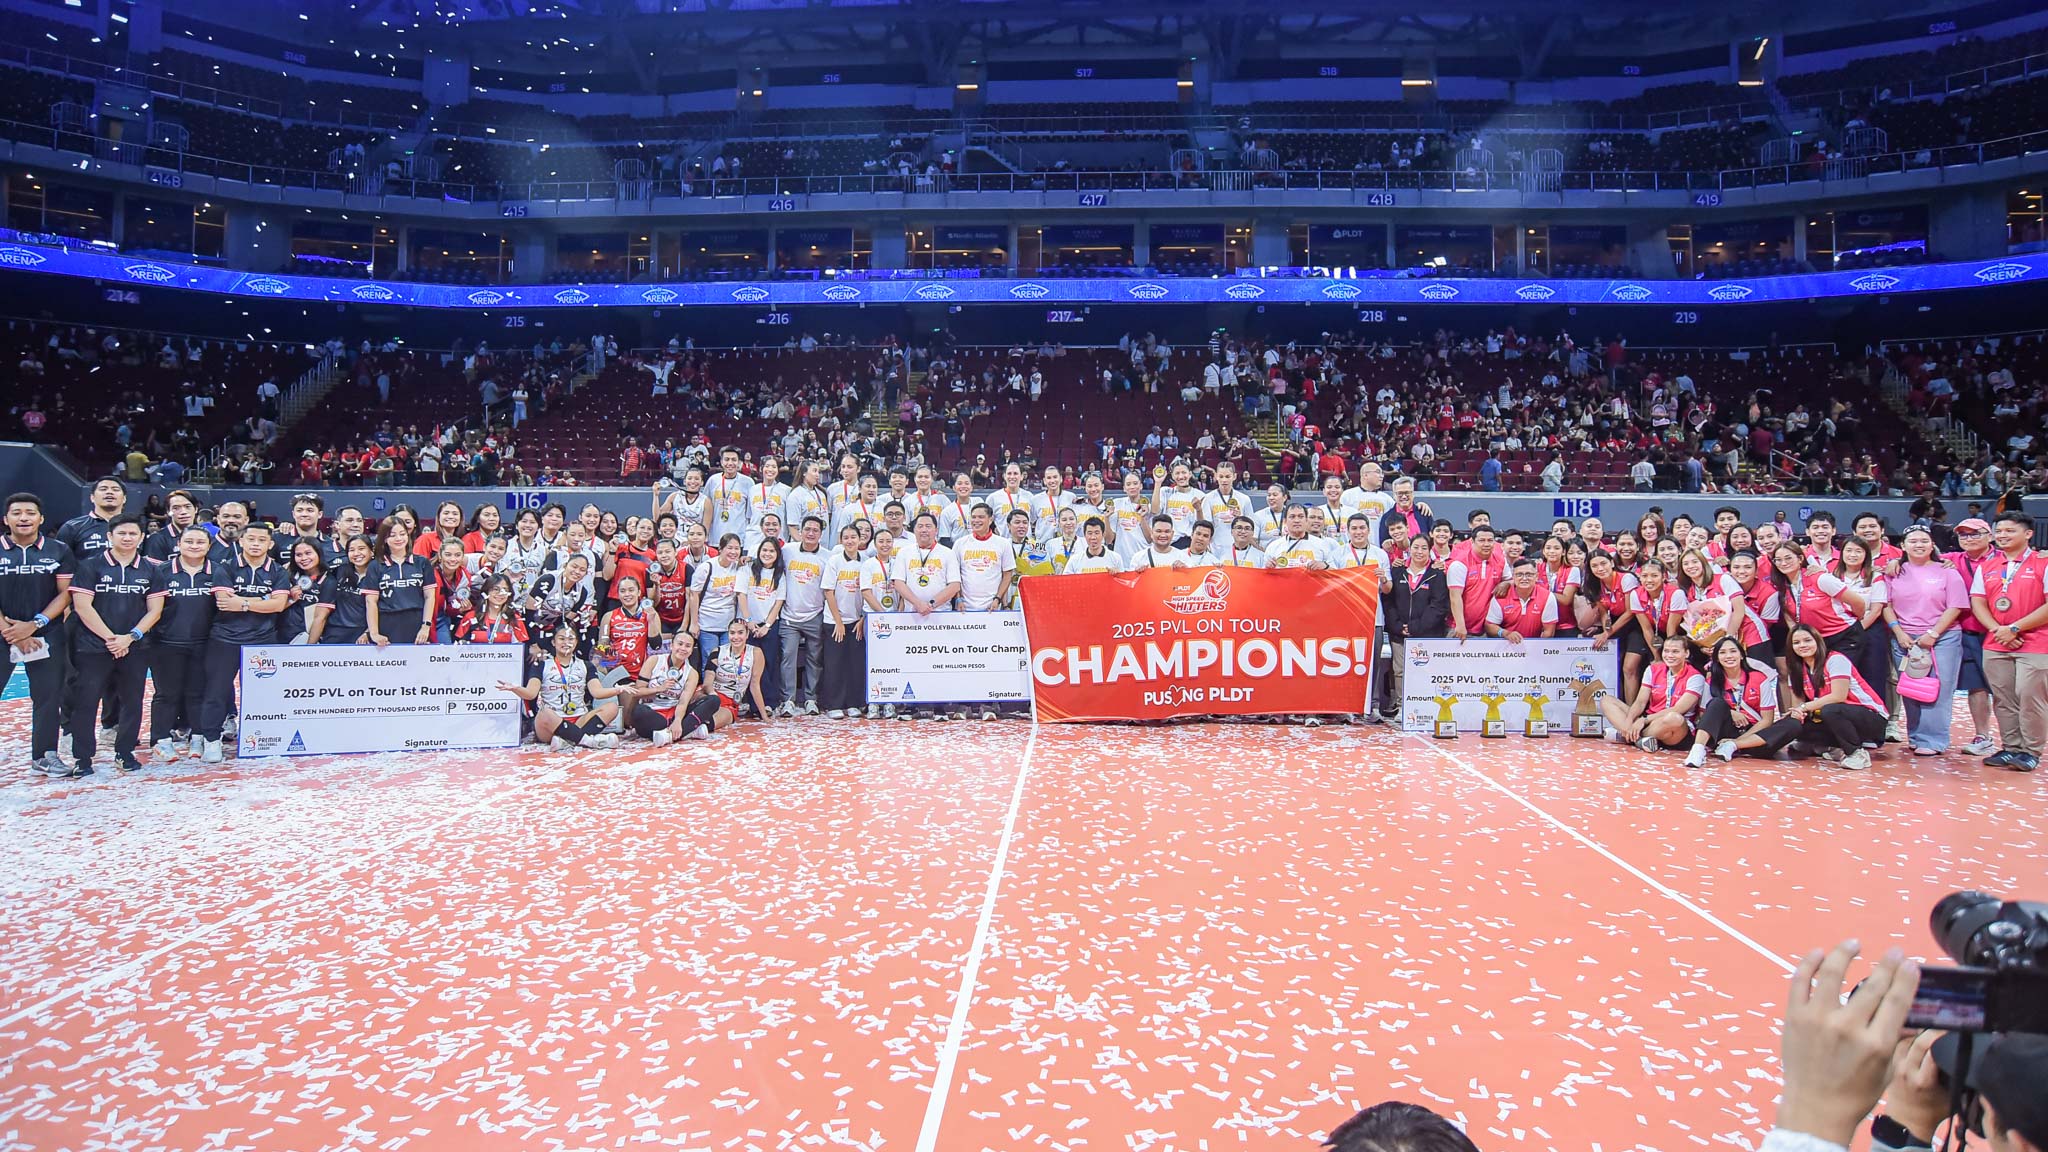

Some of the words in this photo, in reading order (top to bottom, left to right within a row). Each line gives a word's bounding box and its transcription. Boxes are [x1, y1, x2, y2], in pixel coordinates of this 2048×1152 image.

[1076, 69, 1092, 77] 517
[1321, 67, 1337, 76] 518
[824, 74, 839, 82] 516
[551, 84, 565, 92] 515
[150, 173, 181, 187] 414B
[1082, 194, 1104, 205] 417
[1370, 194, 1392, 205] 418
[1696, 194, 1718, 206] 419
[771, 200, 792, 211] 416
[505, 207, 525, 216] 415
[1342, 230, 1363, 238] PLDT
[130, 269, 169, 282] ARENA
[1981, 270, 2023, 282] ARENA
[251, 284, 282, 294] ARENA
[1856, 280, 1892, 291] ARENA
[356, 289, 389, 300] ARENA
[647, 294, 673, 303] ARENA
[737, 293, 764, 301] ARENA
[828, 291, 855, 301] ARENA
[921, 290, 950, 300] ARENA
[1014, 289, 1044, 299] ARENA
[1133, 289, 1163, 299] ARENA
[1230, 289, 1260, 299] ARENA
[1327, 290, 1357, 299] ARENA
[1424, 290, 1454, 300] ARENA
[1521, 290, 1550, 300] ARENA
[1617, 291, 1647, 300] ARENA
[1714, 290, 1745, 300] ARENA
[472, 295, 499, 305] ARENA
[558, 295, 584, 304] ARENA
[768, 313, 789, 325] 216
[1050, 310, 1072, 323] 217
[1361, 310, 1383, 323] 218
[1675, 312, 1697, 324] 219
[505, 316, 524, 328] 215
[512, 492, 540, 509] 116
[1561, 499, 1592, 517] 118
[95, 583, 150, 594] CHERY
[379, 579, 424, 590] CHERY
[664, 599, 680, 610] 21
[1175, 601, 1226, 612] HITTERS
[880, 623, 891, 631] PVL
[1112, 622, 1156, 639] 2025
[1160, 620, 1192, 635] PVL
[1196, 618, 1223, 634] ON
[1229, 618, 1281, 633] TOUR
[613, 631, 646, 639] CHERY
[905, 646, 928, 655] 2025
[931, 646, 950, 654] PVL
[967, 645, 988, 653] Tour
[991, 645, 1025, 655] Champ
[1418, 649, 1428, 657] PVL
[261, 659, 276, 668] PVL
[321, 660, 374, 668] VOLLEYBALL
[429, 655, 451, 663] Date
[1033, 638, 1367, 686] CHAMPIONS!
[1431, 676, 1454, 684] 2025
[1457, 675, 1476, 684] PVL
[1493, 675, 1517, 684] Tour
[1518, 675, 1537, 684] 2nd
[723, 680, 737, 692] 2
[284, 688, 315, 699] 2025
[319, 688, 345, 698] PVL
[348, 689, 365, 698] on
[368, 687, 397, 697] Tour
[400, 686, 417, 696] 1st
[421, 686, 486, 697] Runner-up
[988, 691, 1022, 699] Signature
[1209, 688, 1254, 702] PLDT
[558, 693, 572, 705] 11
[418, 705, 441, 713] PESOS
[466, 702, 508, 713] 750,000
[245, 713, 287, 722] Amount:
[405, 739, 448, 749] Signature
